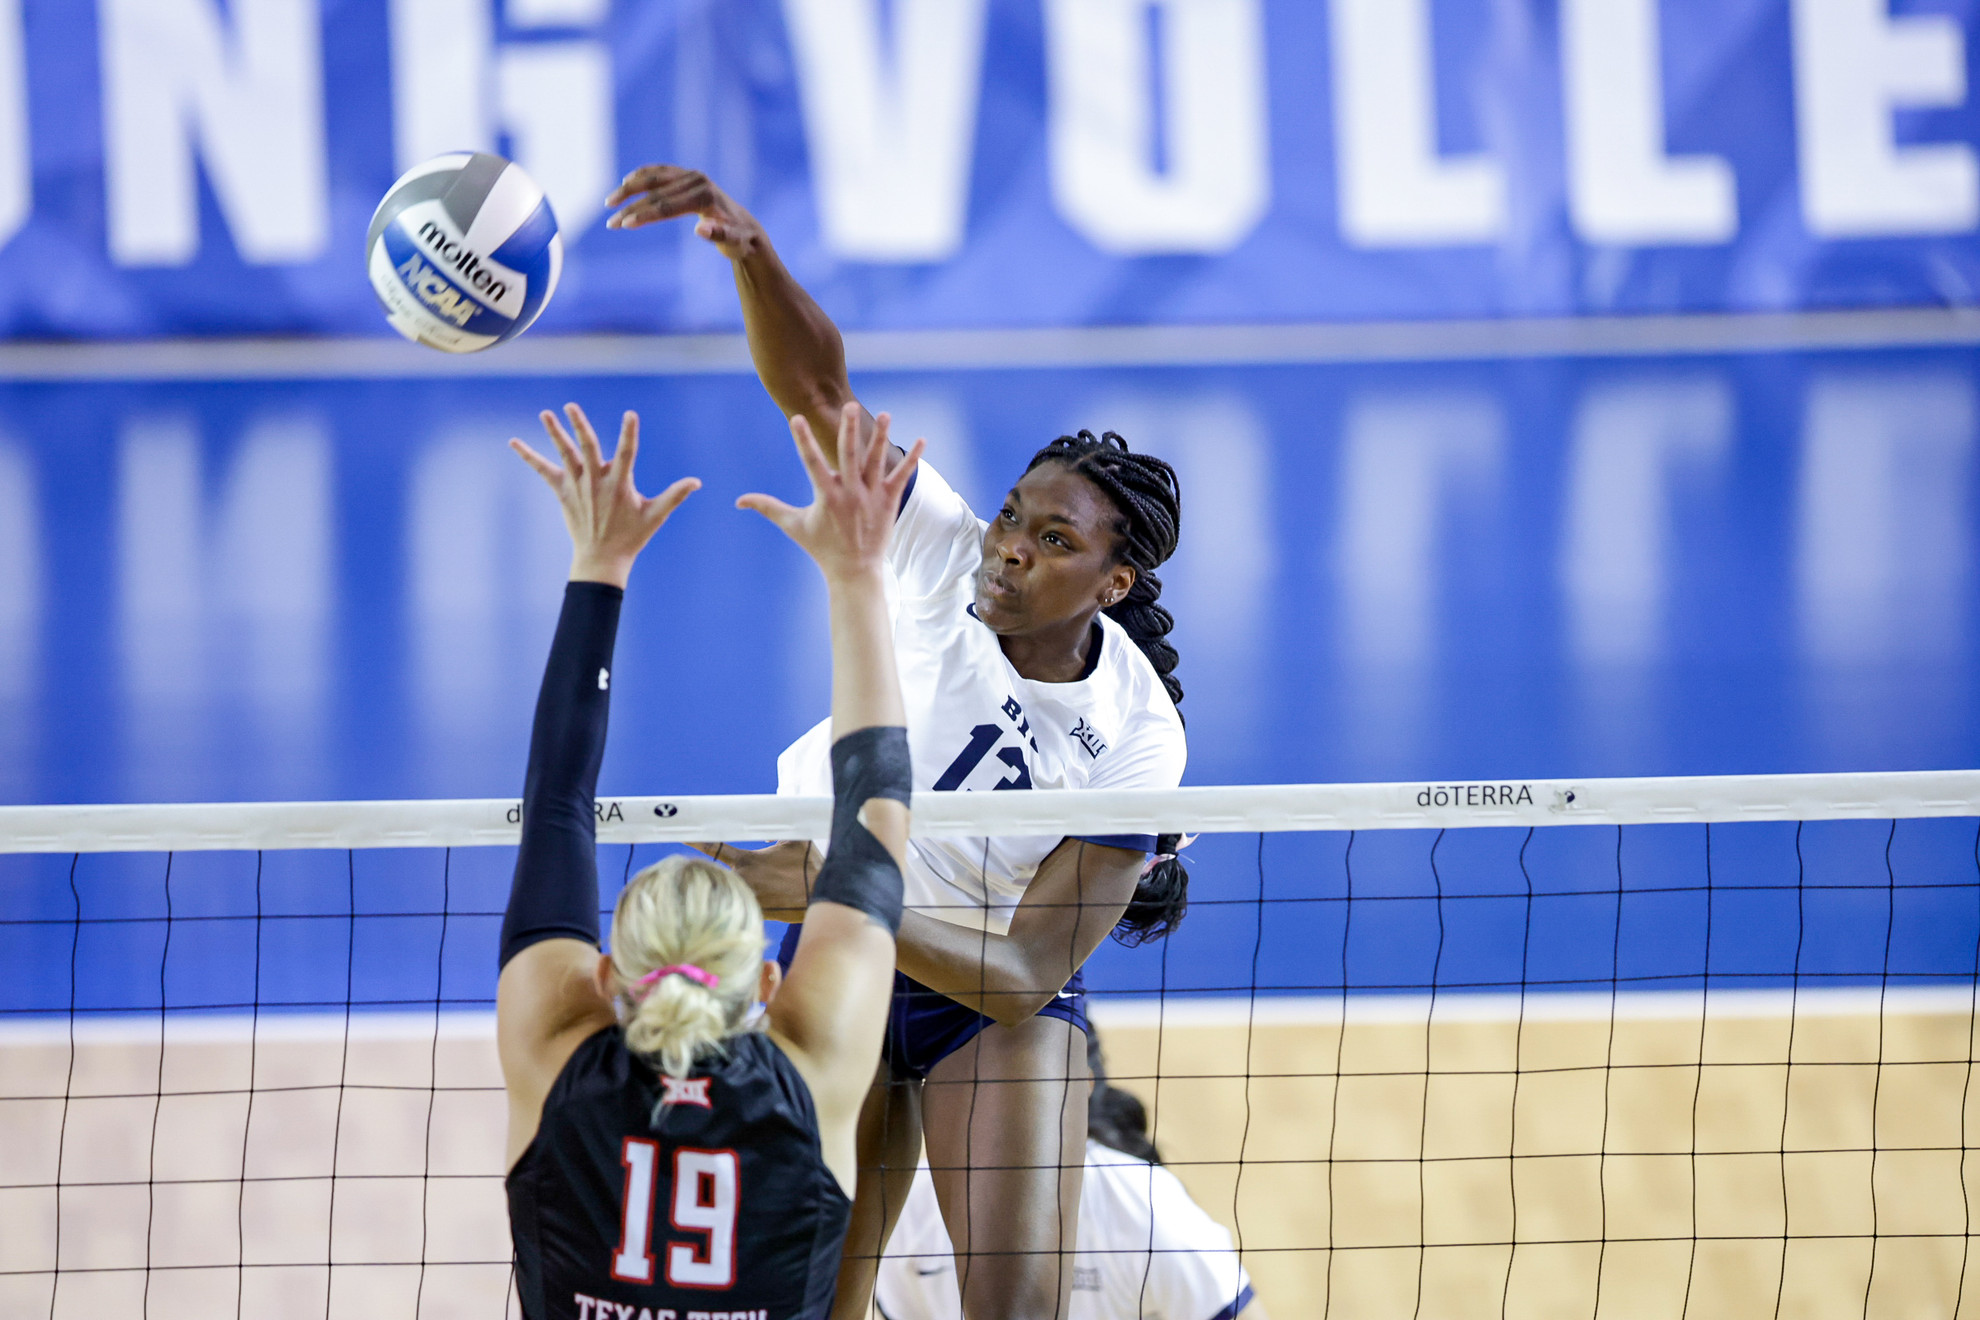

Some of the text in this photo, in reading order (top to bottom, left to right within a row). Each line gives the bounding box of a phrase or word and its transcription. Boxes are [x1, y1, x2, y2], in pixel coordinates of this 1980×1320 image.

[397, 252, 477, 327] NCAA
[418, 220, 506, 303] molten
[610, 1136, 739, 1290] 19
